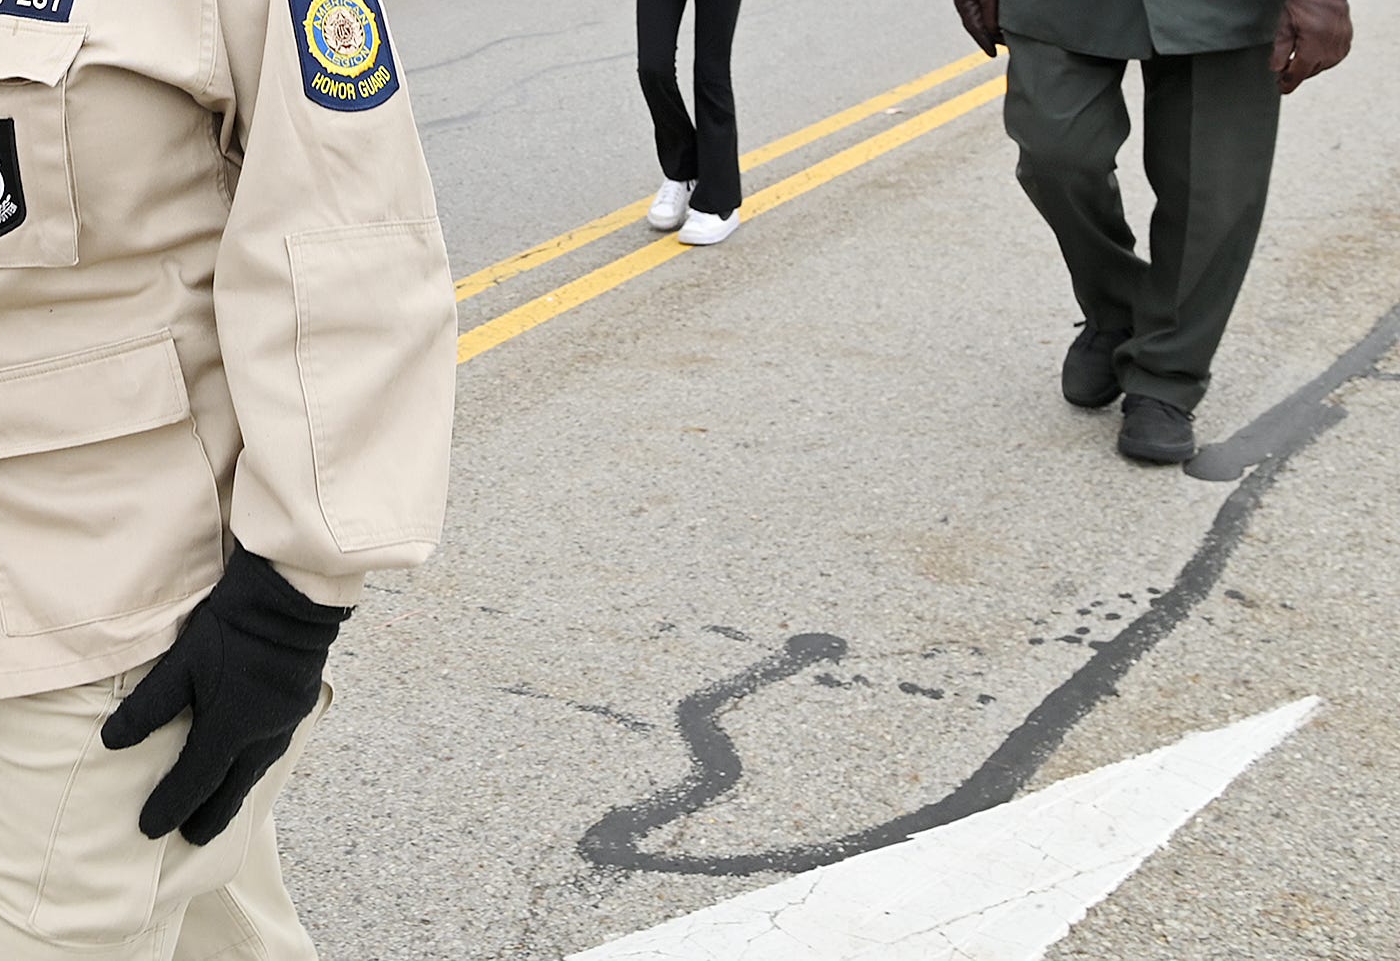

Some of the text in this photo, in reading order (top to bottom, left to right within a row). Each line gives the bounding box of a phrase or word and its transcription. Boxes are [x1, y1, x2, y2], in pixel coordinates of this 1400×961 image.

[324, 46, 372, 68] LEGION
[311, 65, 391, 100] HONOR GUARD
